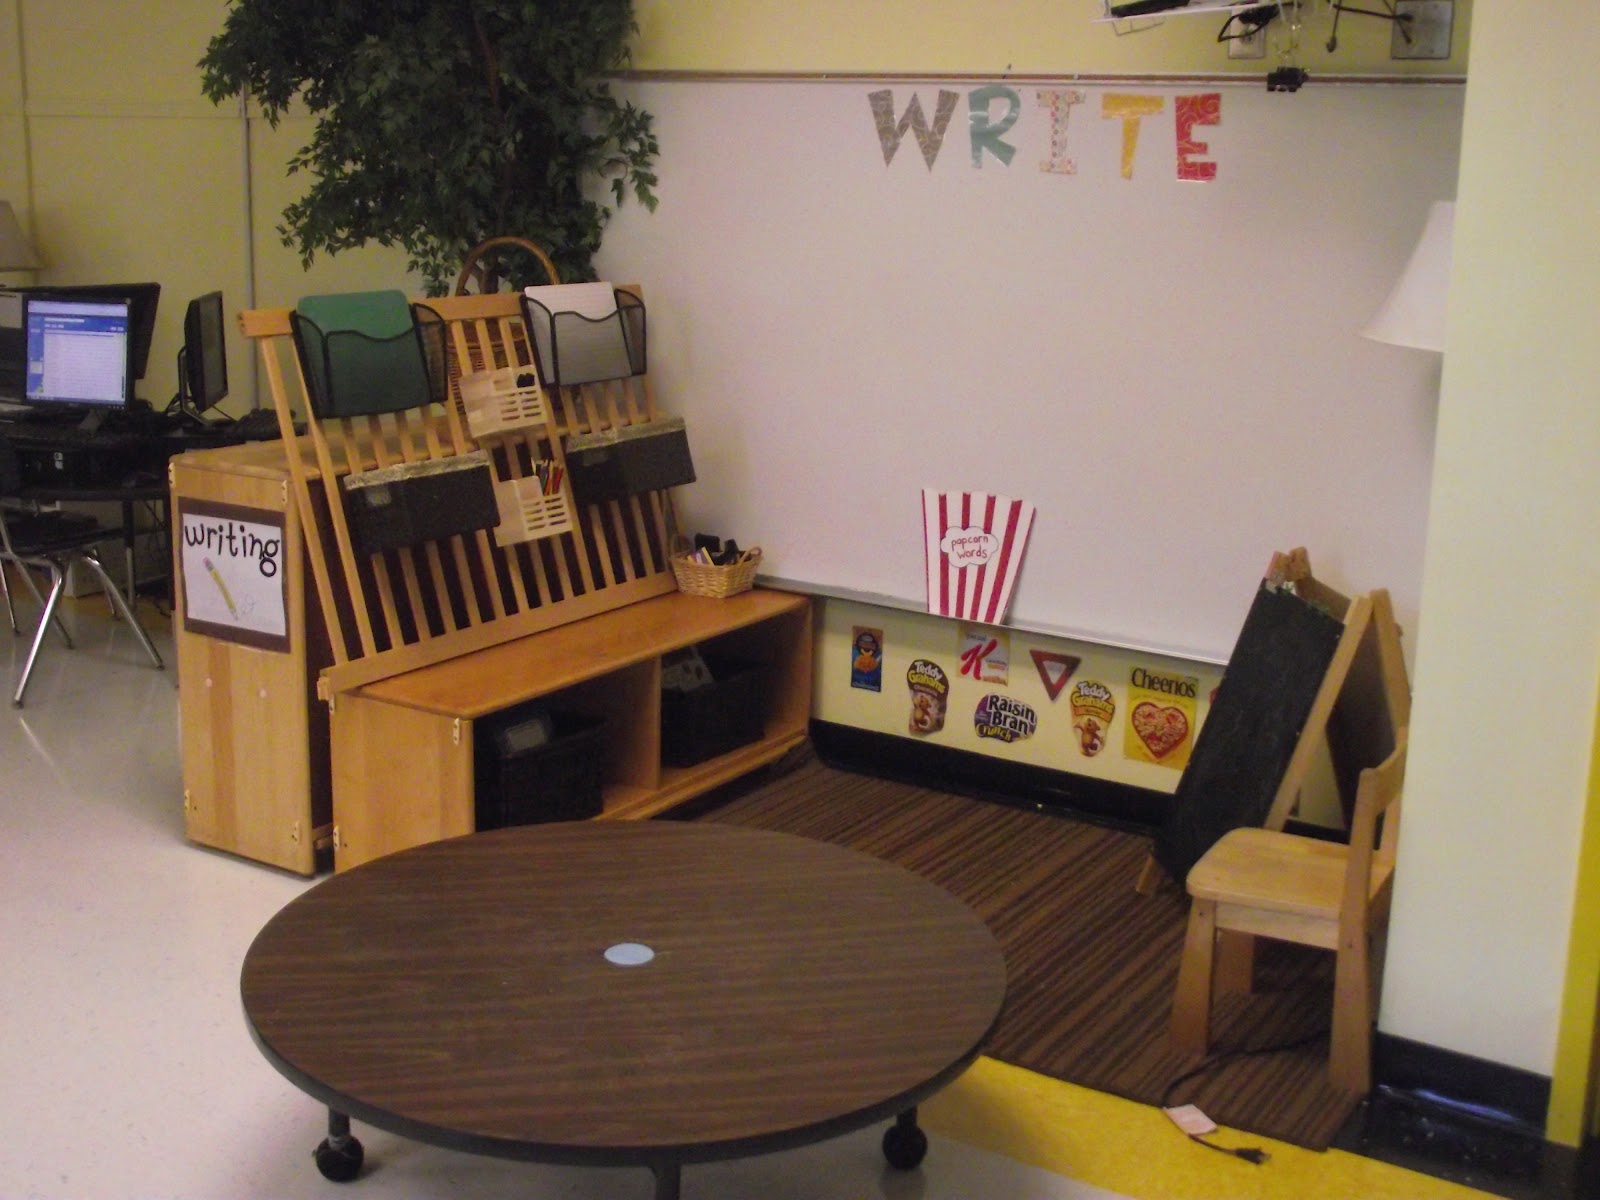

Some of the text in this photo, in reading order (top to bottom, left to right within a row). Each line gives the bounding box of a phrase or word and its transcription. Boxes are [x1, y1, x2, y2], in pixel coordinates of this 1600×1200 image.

[867, 86, 1222, 183] WRITE
[184, 521, 281, 578] writing
[951, 535, 989, 552] popcorn
[957, 544, 988, 560] words
[914, 660, 943, 680] Teddy
[960, 638, 998, 681] K
[908, 669, 946, 694] Grahams
[1077, 681, 1111, 701] Teddy
[1131, 667, 1196, 698] Cheerios
[988, 694, 1036, 723] Raisin
[1071, 691, 1115, 716] Grahams
[976, 723, 1012, 742] Crunch
[992, 709, 1029, 736] Bran
